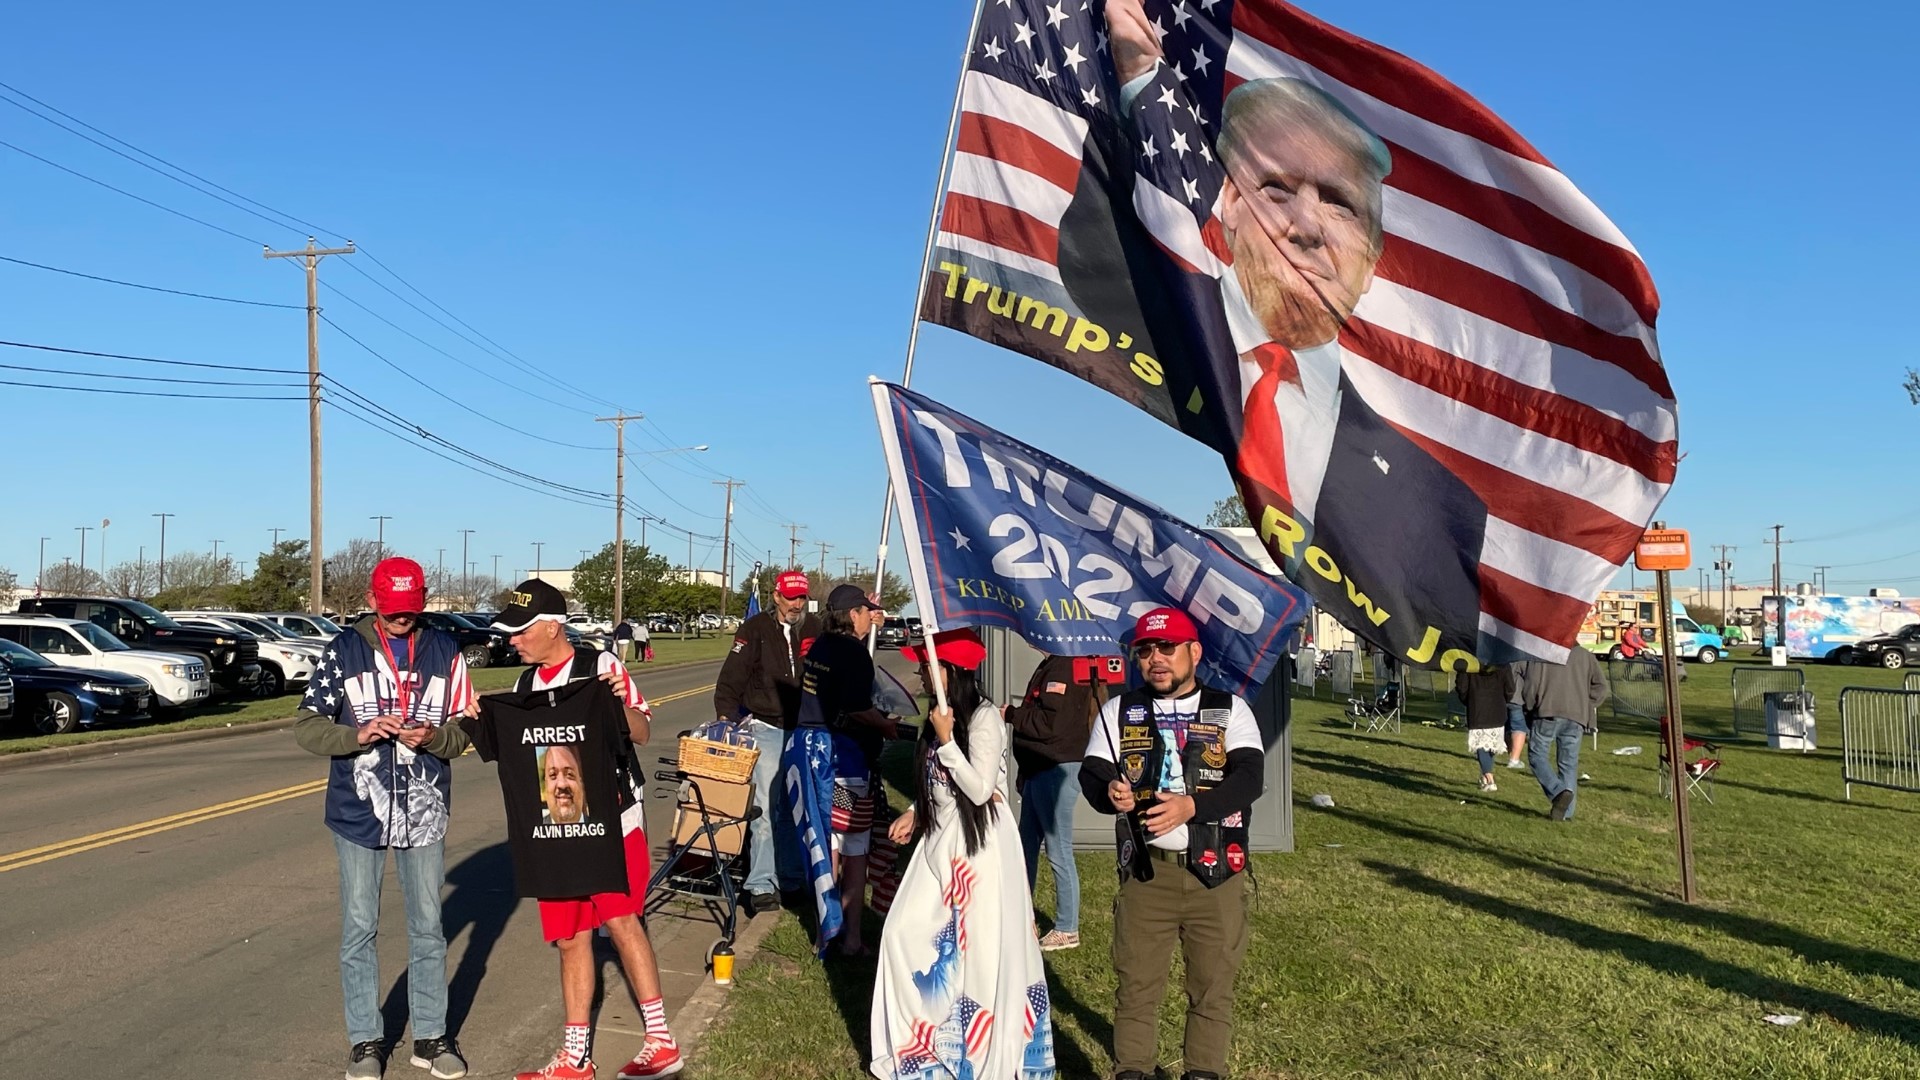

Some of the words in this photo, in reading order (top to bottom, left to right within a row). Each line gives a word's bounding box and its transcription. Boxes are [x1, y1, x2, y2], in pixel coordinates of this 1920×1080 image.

[939, 261, 1165, 386] Trump's
[1643, 535, 1682, 543] WARNING
[1261, 504, 1391, 627] Row
[956, 577, 1025, 613] KEEP
[1146, 614, 1170, 622] TRUMP
[1145, 624, 1167, 632] RIGHT
[344, 671, 446, 727] USA
[521, 725, 586, 744] ARREST
[1199, 768, 1224, 777] TRUMP
[532, 825, 562, 839] ALVIN
[564, 823, 605, 838] BRAGG
